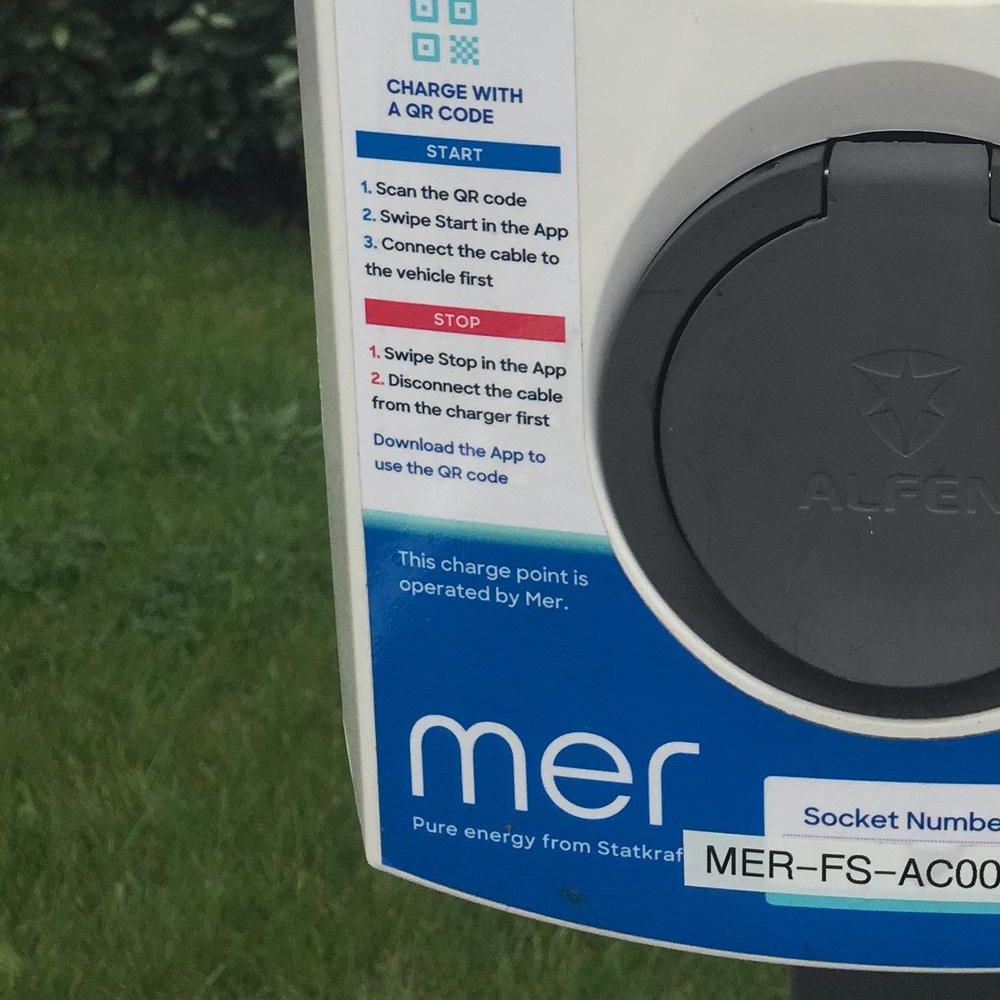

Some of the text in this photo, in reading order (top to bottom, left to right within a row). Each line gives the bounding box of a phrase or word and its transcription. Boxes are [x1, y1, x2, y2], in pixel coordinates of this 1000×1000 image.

[387, 79, 523, 103] CHARGE WITH
[388, 101, 494, 124] A QR CODE
[427, 144, 483, 161] START
[361, 181, 527, 207] 1. Scan the QR code
[365, 262, 493, 287] the vehicle first
[434, 313, 480, 328] STOP
[372, 395, 550, 427] from the charger first
[374, 433, 546, 464] Download the App to
[375, 460, 508, 485] use the QR code
[398, 550, 588, 586] This charge point is
[399, 579, 568, 610] operated by Mer.
[409, 714, 700, 826] mer
[804, 807, 899, 829] Socket
[413, 816, 684, 863] Pure energy from Statkraf
